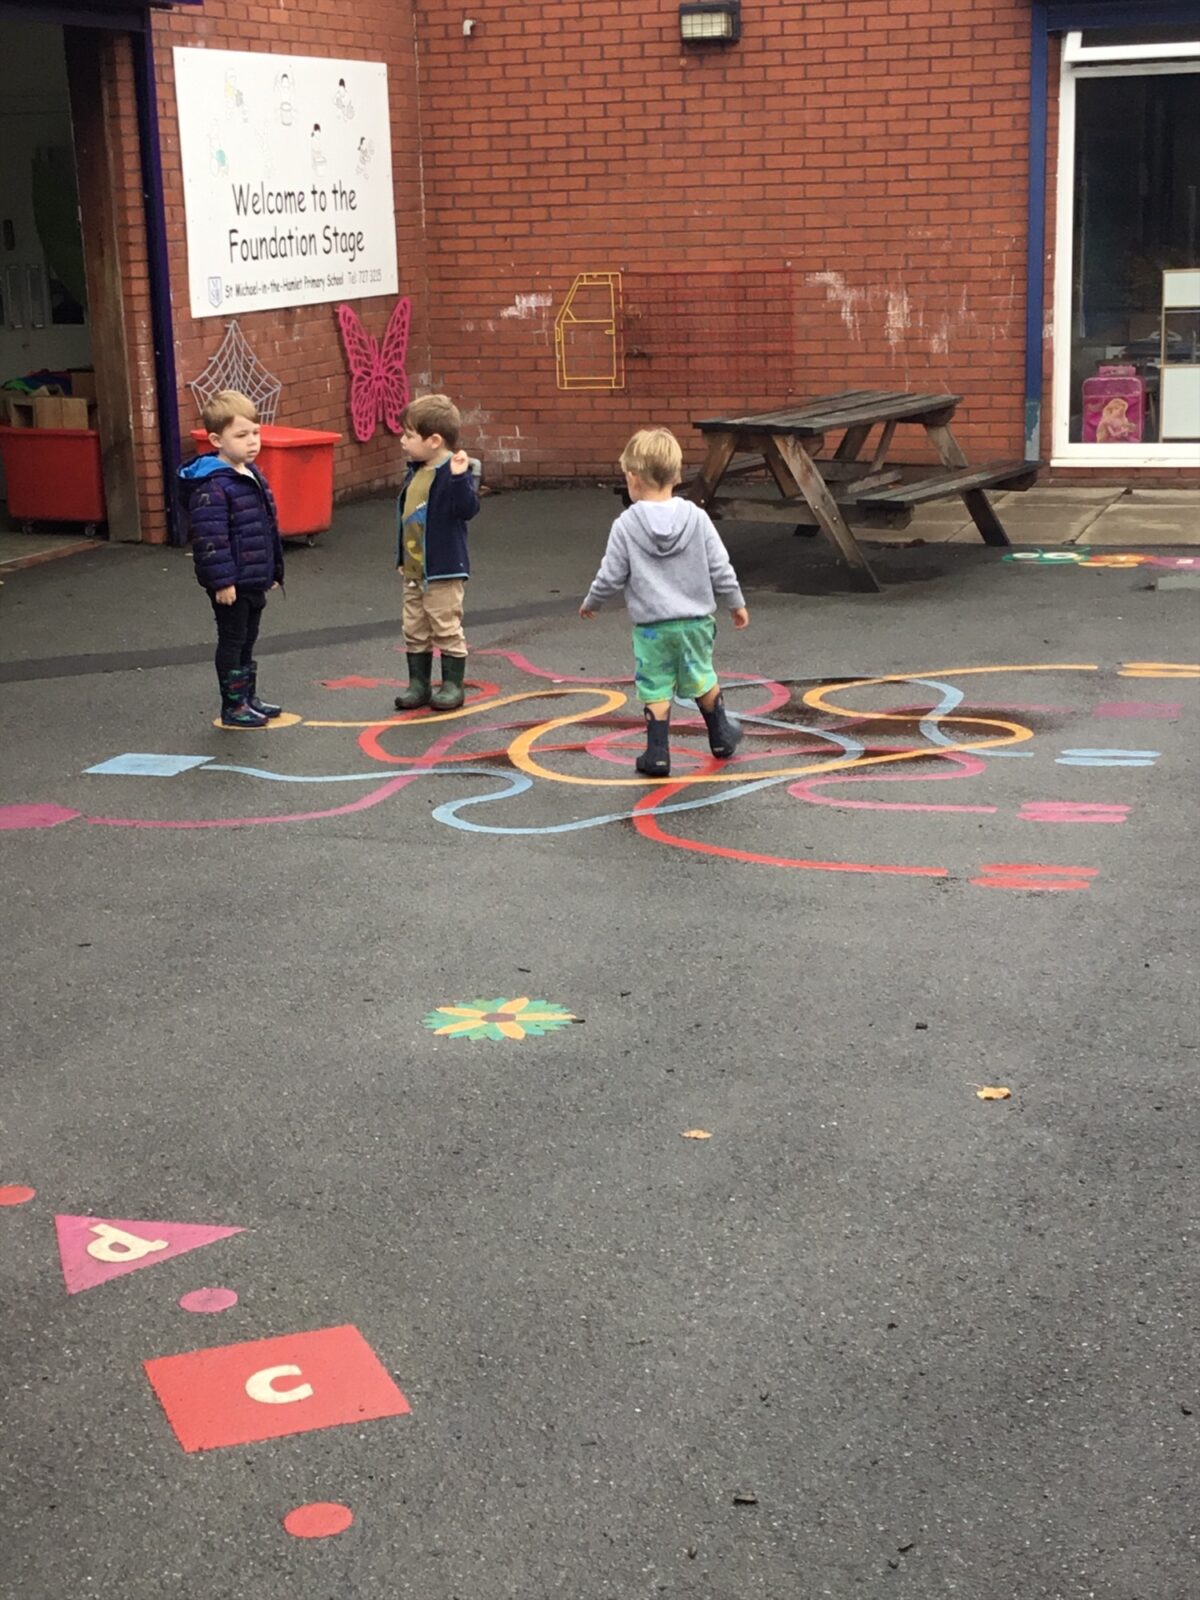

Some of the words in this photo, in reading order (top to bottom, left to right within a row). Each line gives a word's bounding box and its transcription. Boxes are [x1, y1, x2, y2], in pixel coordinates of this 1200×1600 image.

[232, 180, 307, 217] Welcome
[311, 183, 328, 213] to
[331, 179, 358, 212] the
[228, 225, 318, 264] Foundation
[322, 224, 365, 263] Stage
[303, 275, 325, 293] Primary
[327, 272, 344, 288] School
[245, 1364, 314, 1404] c
